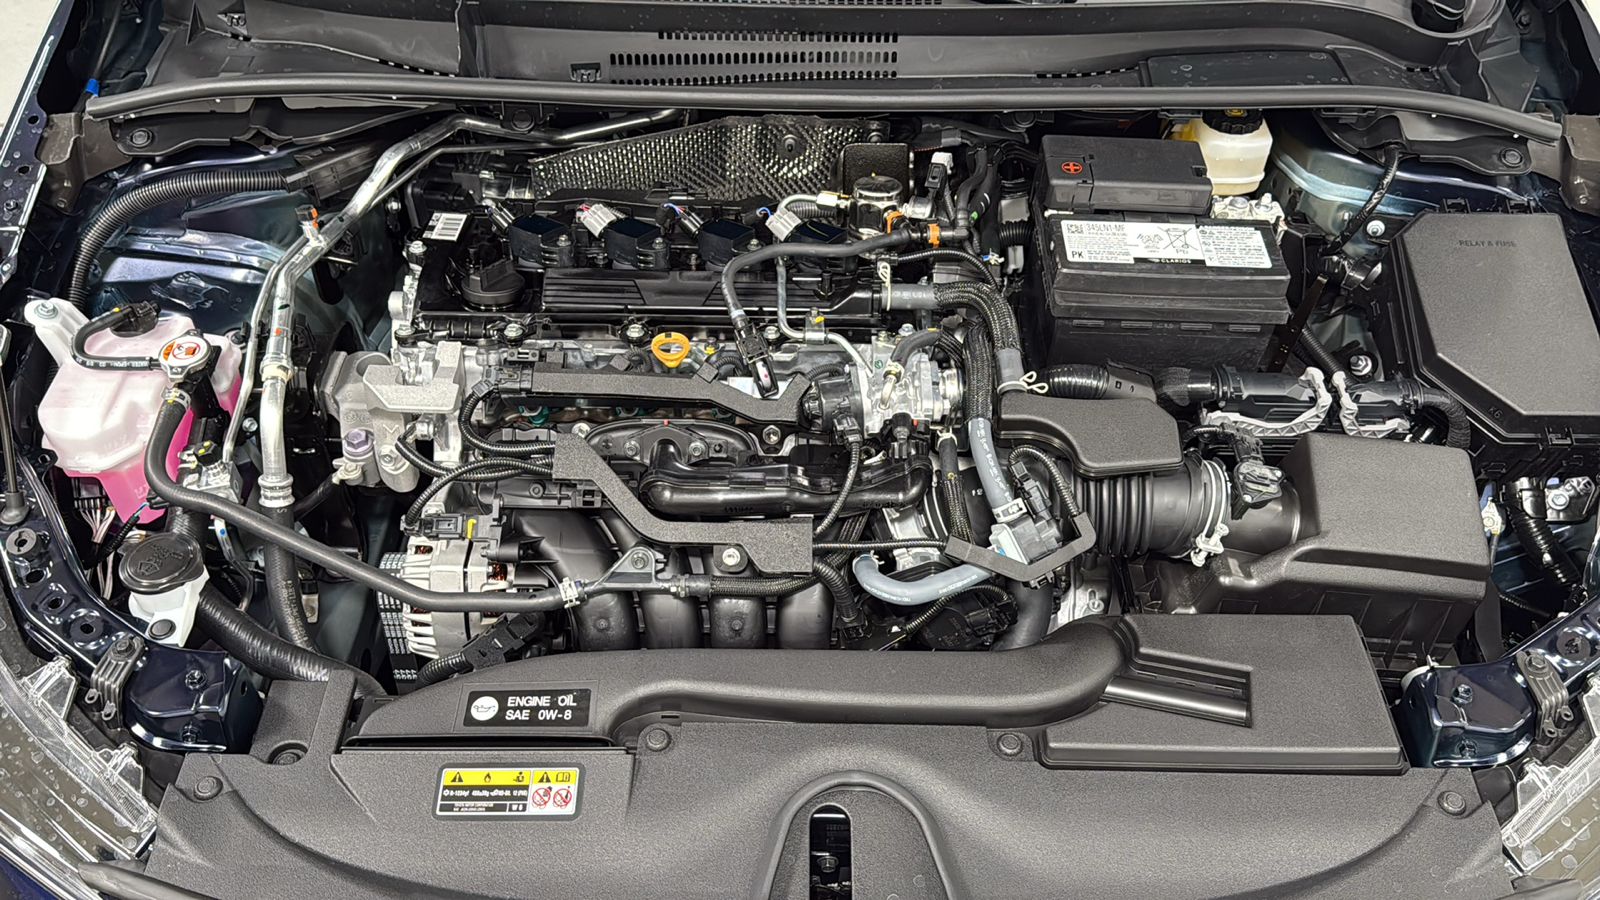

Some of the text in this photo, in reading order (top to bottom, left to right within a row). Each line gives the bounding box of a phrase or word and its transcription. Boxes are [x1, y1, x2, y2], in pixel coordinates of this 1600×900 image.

[1459, 239, 1517, 248] RELAY & FUSE
[1071, 250, 1084, 259] PK
[507, 694, 577, 707] ENGINE OIL
[505, 709, 572, 720] SAE 0W-8
